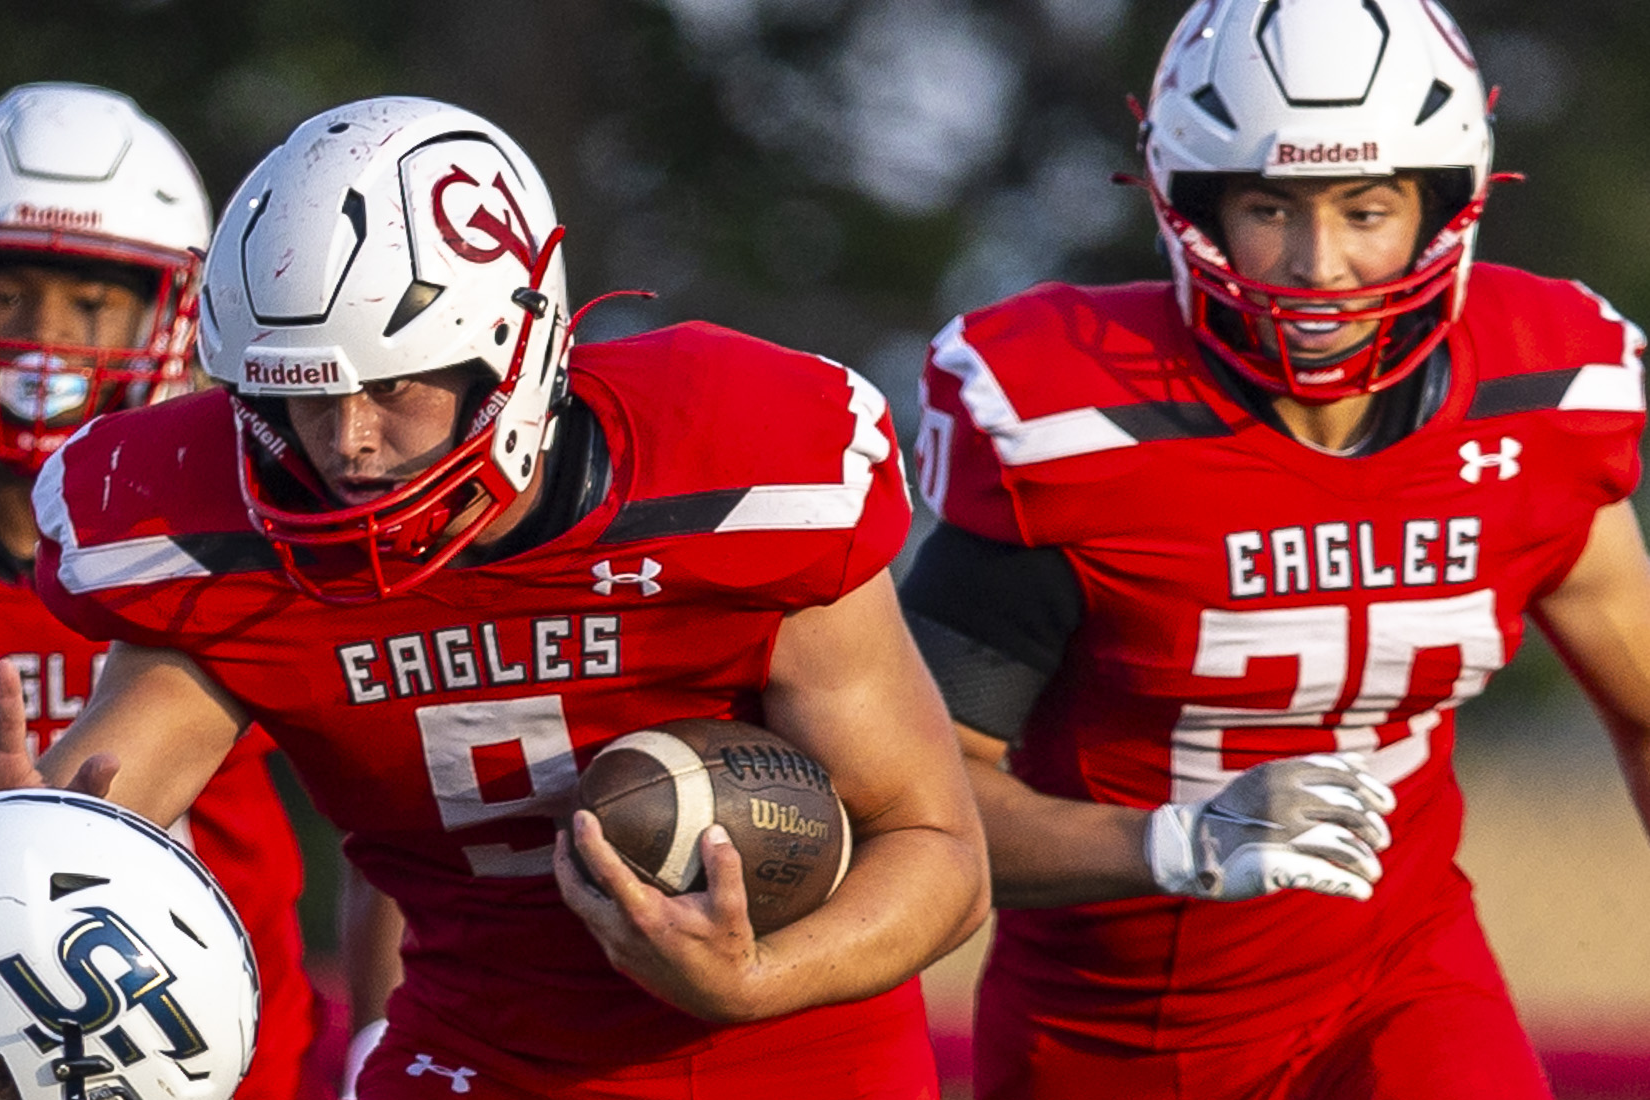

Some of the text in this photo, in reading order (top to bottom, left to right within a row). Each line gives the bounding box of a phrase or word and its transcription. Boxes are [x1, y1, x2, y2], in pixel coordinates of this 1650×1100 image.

[1276, 142, 1378, 164] Riddell
[245, 361, 340, 384] Riddell
[1224, 515, 1482, 600] EAGLES
[336, 614, 622, 706] EAGLES
[1170, 586, 1507, 802] 20
[415, 693, 580, 879] 9
[749, 797, 829, 841] Wilson
